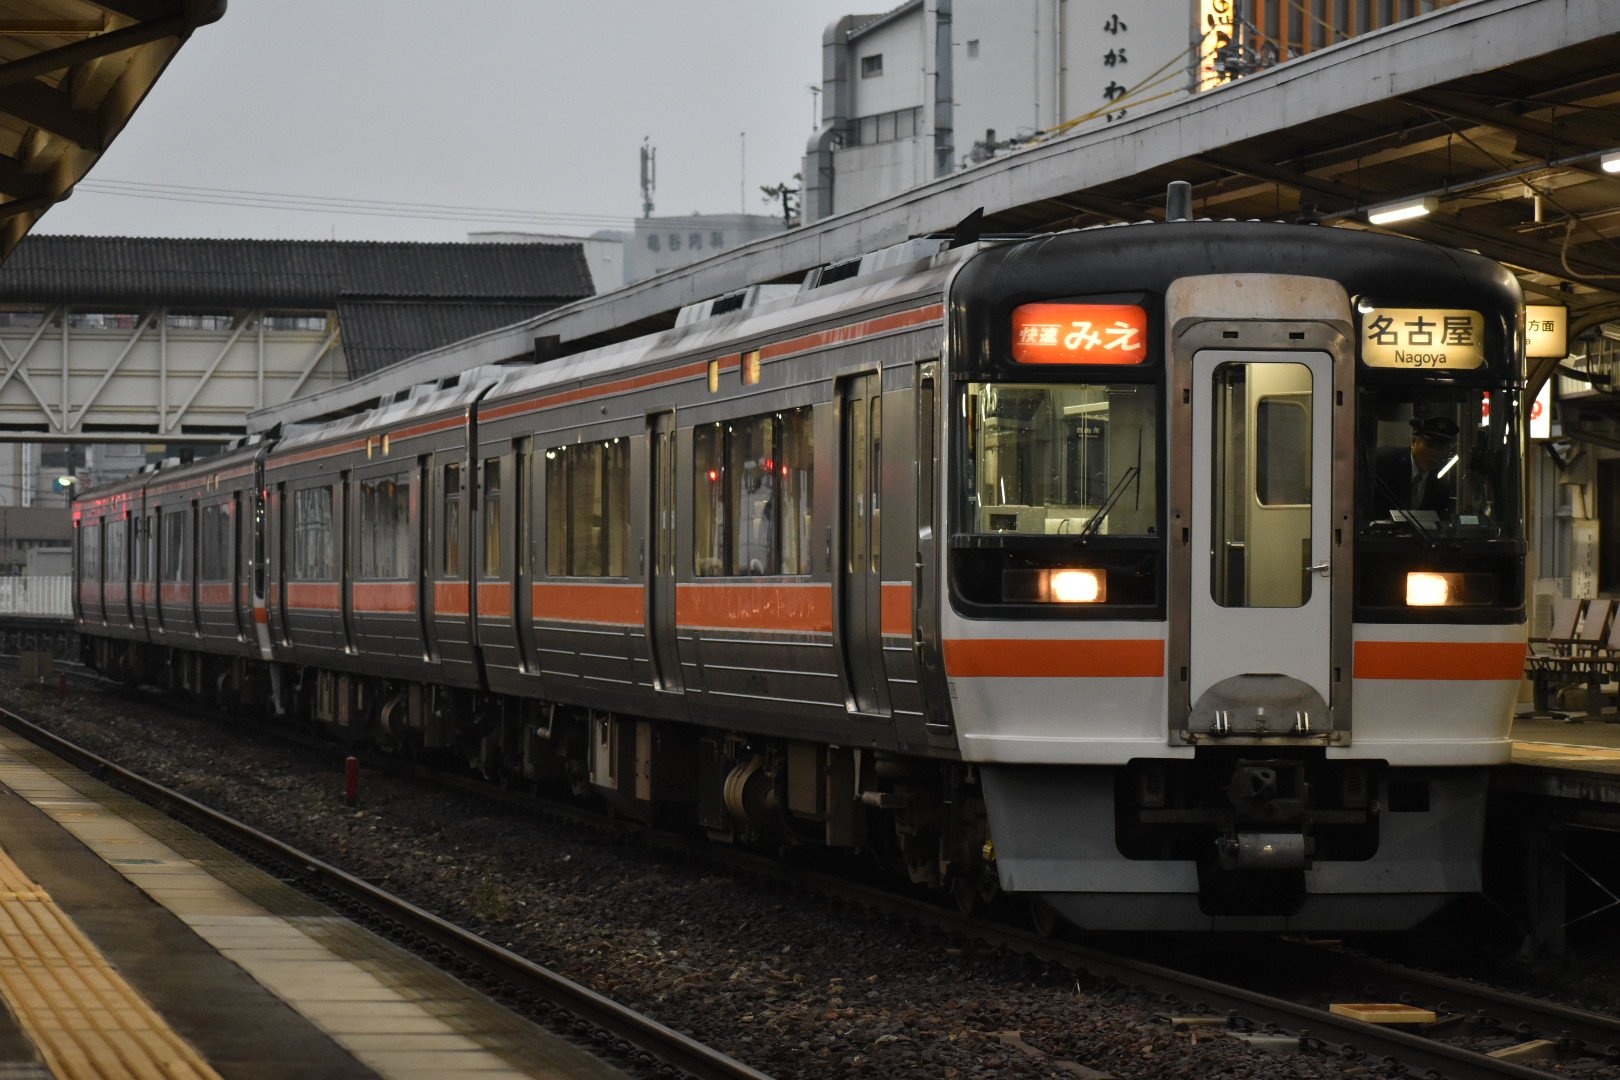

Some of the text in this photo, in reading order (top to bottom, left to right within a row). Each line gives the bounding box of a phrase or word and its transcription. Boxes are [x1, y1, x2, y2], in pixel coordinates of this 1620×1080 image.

[1064, 321, 1141, 351] みえ
[1368, 315, 1474, 346] 名古屋
[1528, 320, 1554, 332] 方面
[1394, 350, 1447, 367] Nagoya
